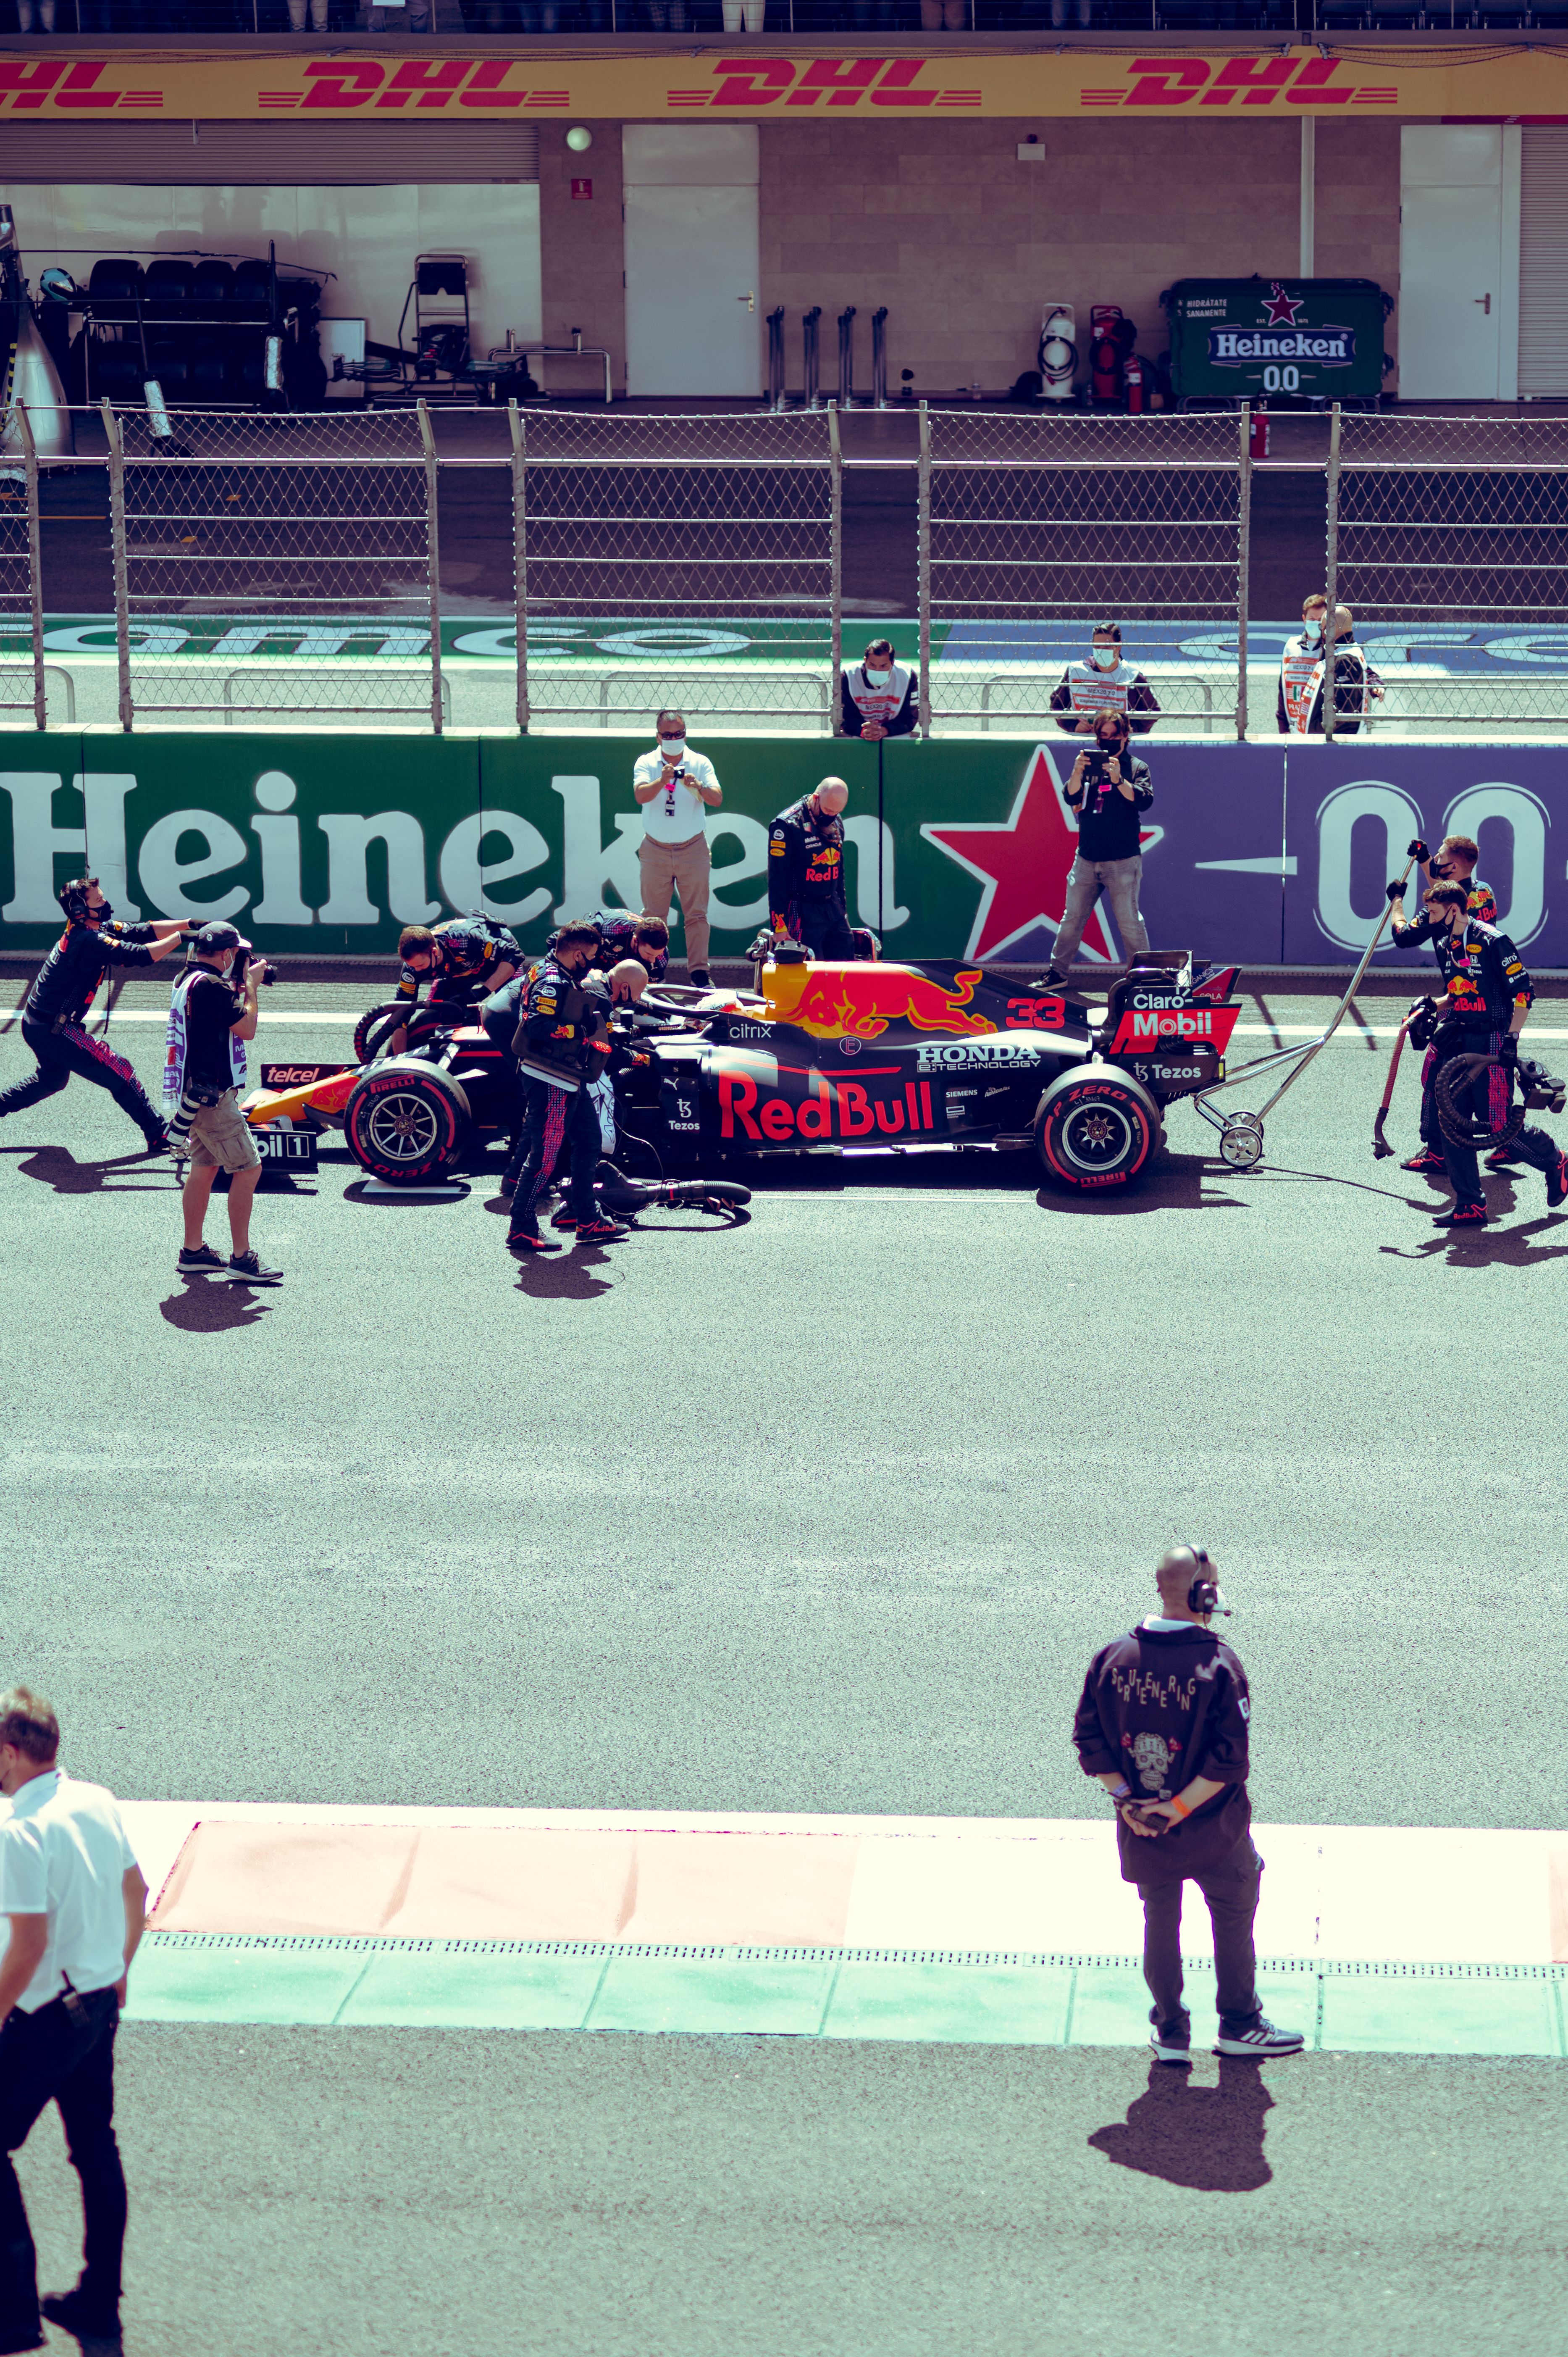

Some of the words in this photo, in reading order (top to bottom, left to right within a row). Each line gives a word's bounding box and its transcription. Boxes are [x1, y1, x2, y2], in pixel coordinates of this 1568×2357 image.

[299, 61, 528, 108] DHL
[709, 59, 940, 106] DHL
[1123, 58, 1356, 105] DHL
[1263, 365, 1299, 392] 0.0
[0, 770, 909, 931] Heineken
[806, 866, 831, 881] Red
[1133, 993, 1184, 1009] Claro
[1006, 997, 1066, 1029] 33
[729, 1023, 772, 1039] citrix
[1134, 1012, 1212, 1036] Mobil
[917, 1044, 1041, 1063] HONDA
[267, 1067, 320, 1083] telcel
[1152, 1064, 1201, 1079] Tezos
[370, 1074, 415, 1094] PIRELLI
[946, 1089, 978, 1098] SIEMENS
[718, 1069, 832, 1141] Red
[836, 1081, 934, 1136] Bull
[1053, 1101, 1062, 1117] P
[1069, 1084, 1129, 1102] ZERO
[668, 1120, 700, 1131] Tezos
[294, 1137, 302, 1155] 1
[373, 1162, 432, 1178] ZERO
[1080, 1171, 1127, 1188] PIRELLI
